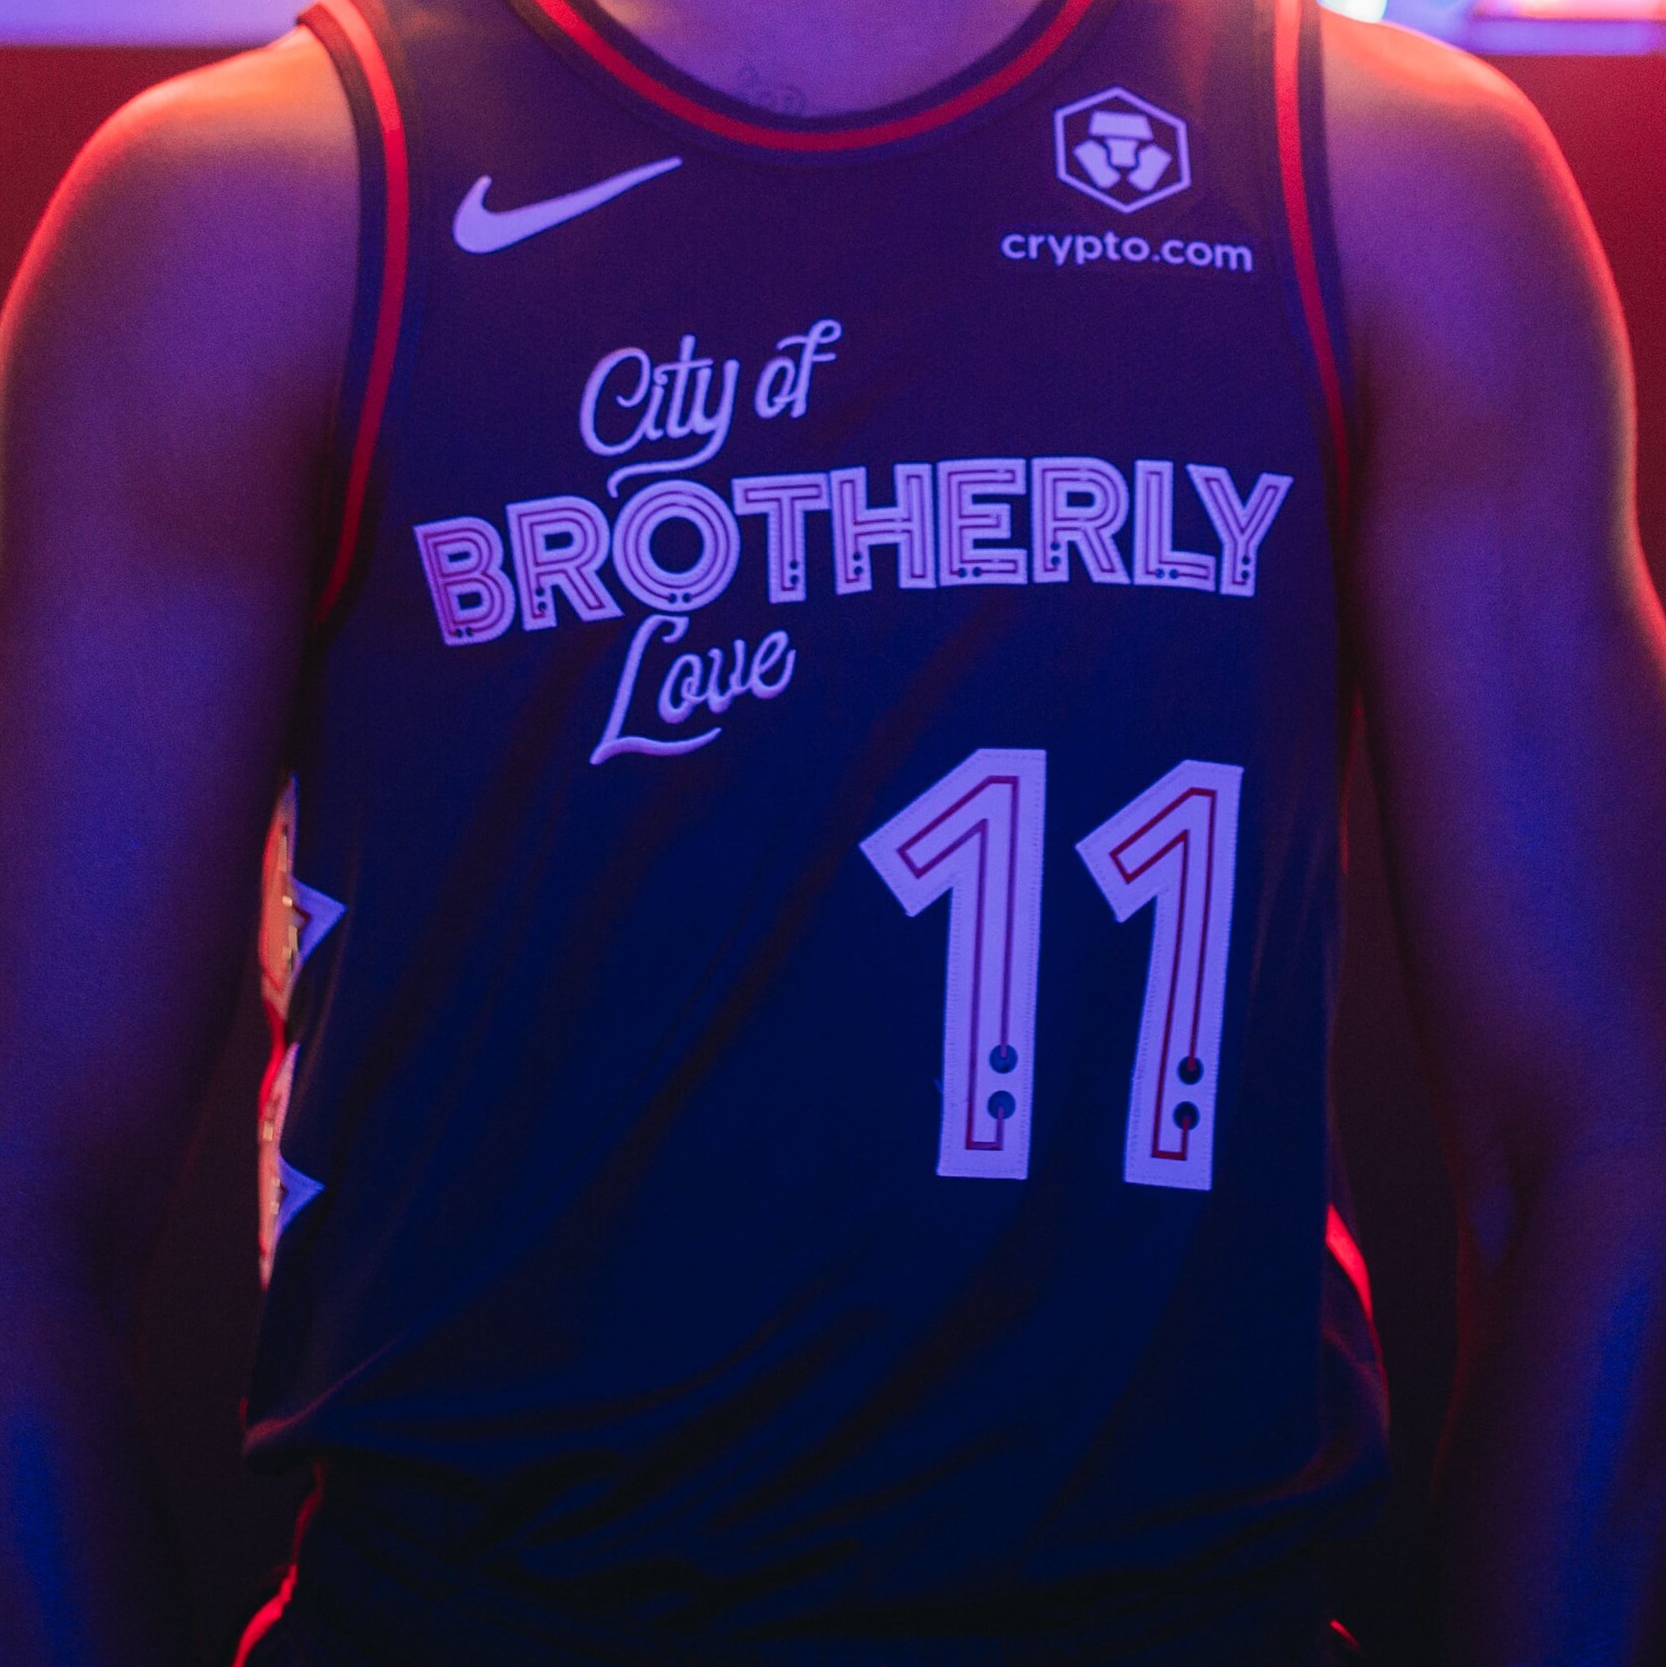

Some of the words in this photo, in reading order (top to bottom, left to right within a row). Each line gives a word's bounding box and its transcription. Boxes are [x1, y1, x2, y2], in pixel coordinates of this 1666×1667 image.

[1000, 230, 1253, 273] crypto.com
[579, 335, 738, 499] City
[754, 319, 842, 418] of
[413, 456, 1293, 646] BROTHERLY
[589, 615, 796, 765] Love
[859, 748, 1244, 1191] 11
